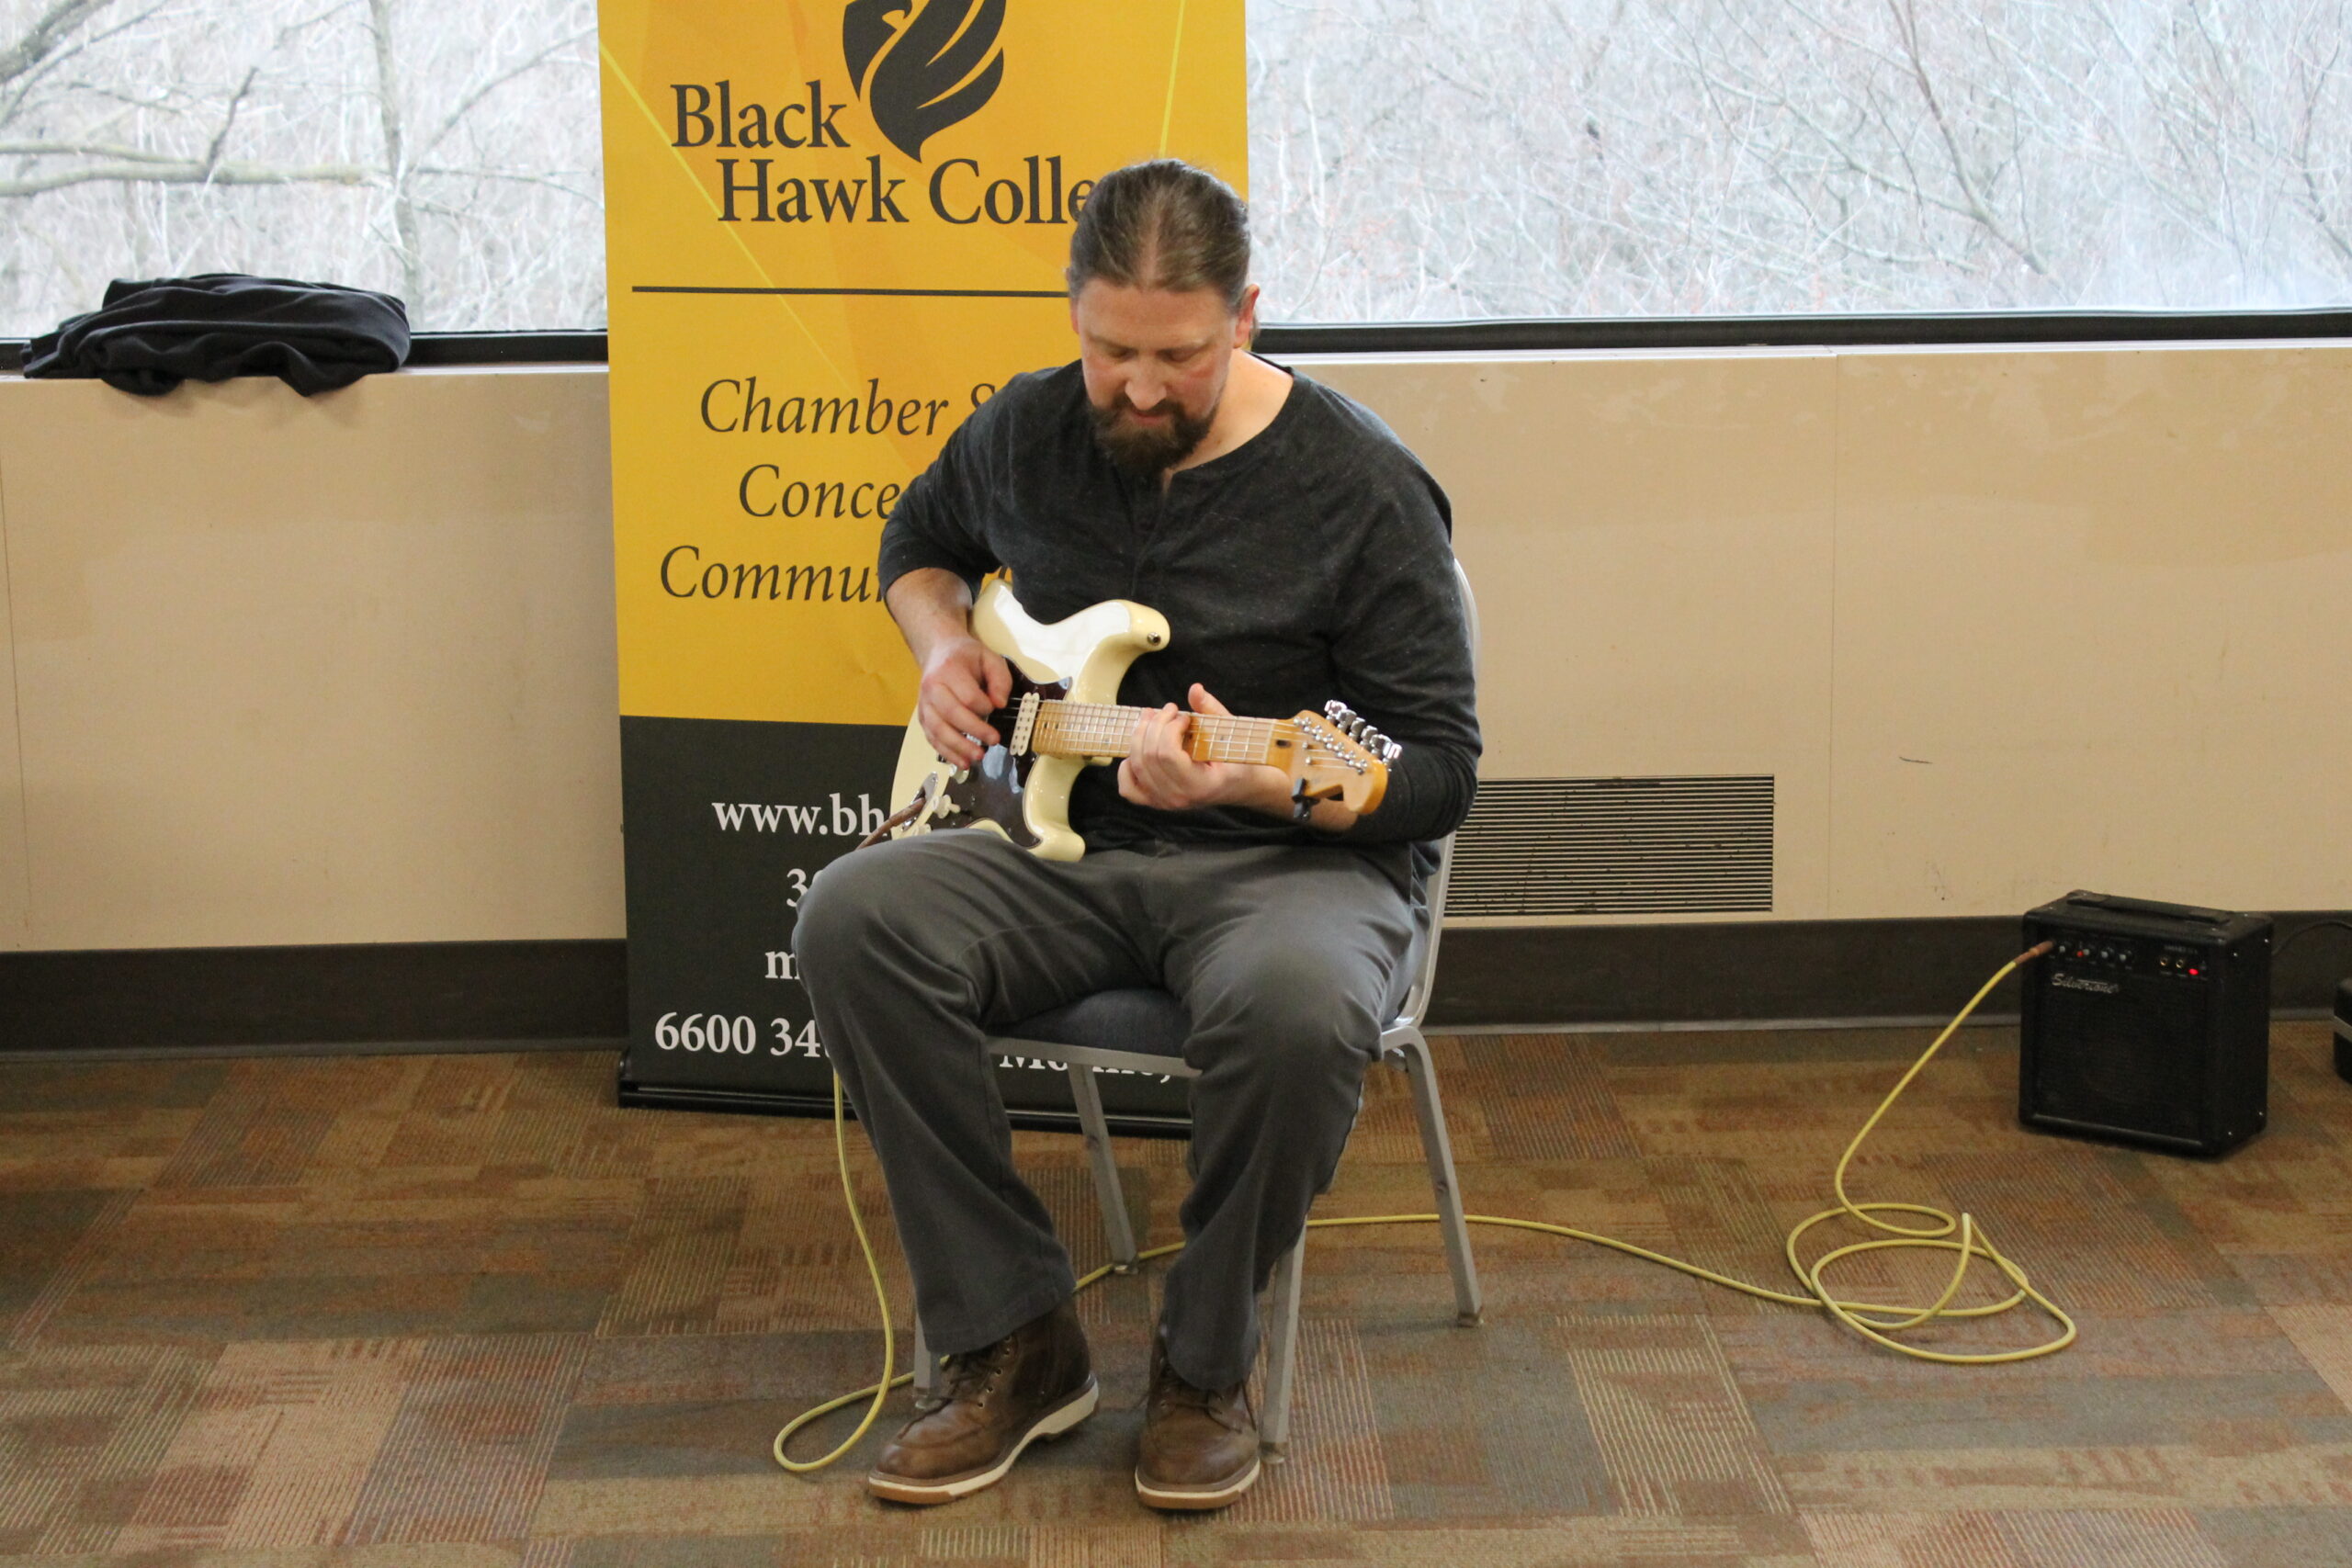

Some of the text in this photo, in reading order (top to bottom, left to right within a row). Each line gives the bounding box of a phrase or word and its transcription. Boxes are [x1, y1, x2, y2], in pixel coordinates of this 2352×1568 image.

[671, 79, 851, 149] Black
[716, 153, 910, 223] Hawk
[701, 376, 949, 436] Chamber
[655, 1011, 830, 1057] 6600 34
